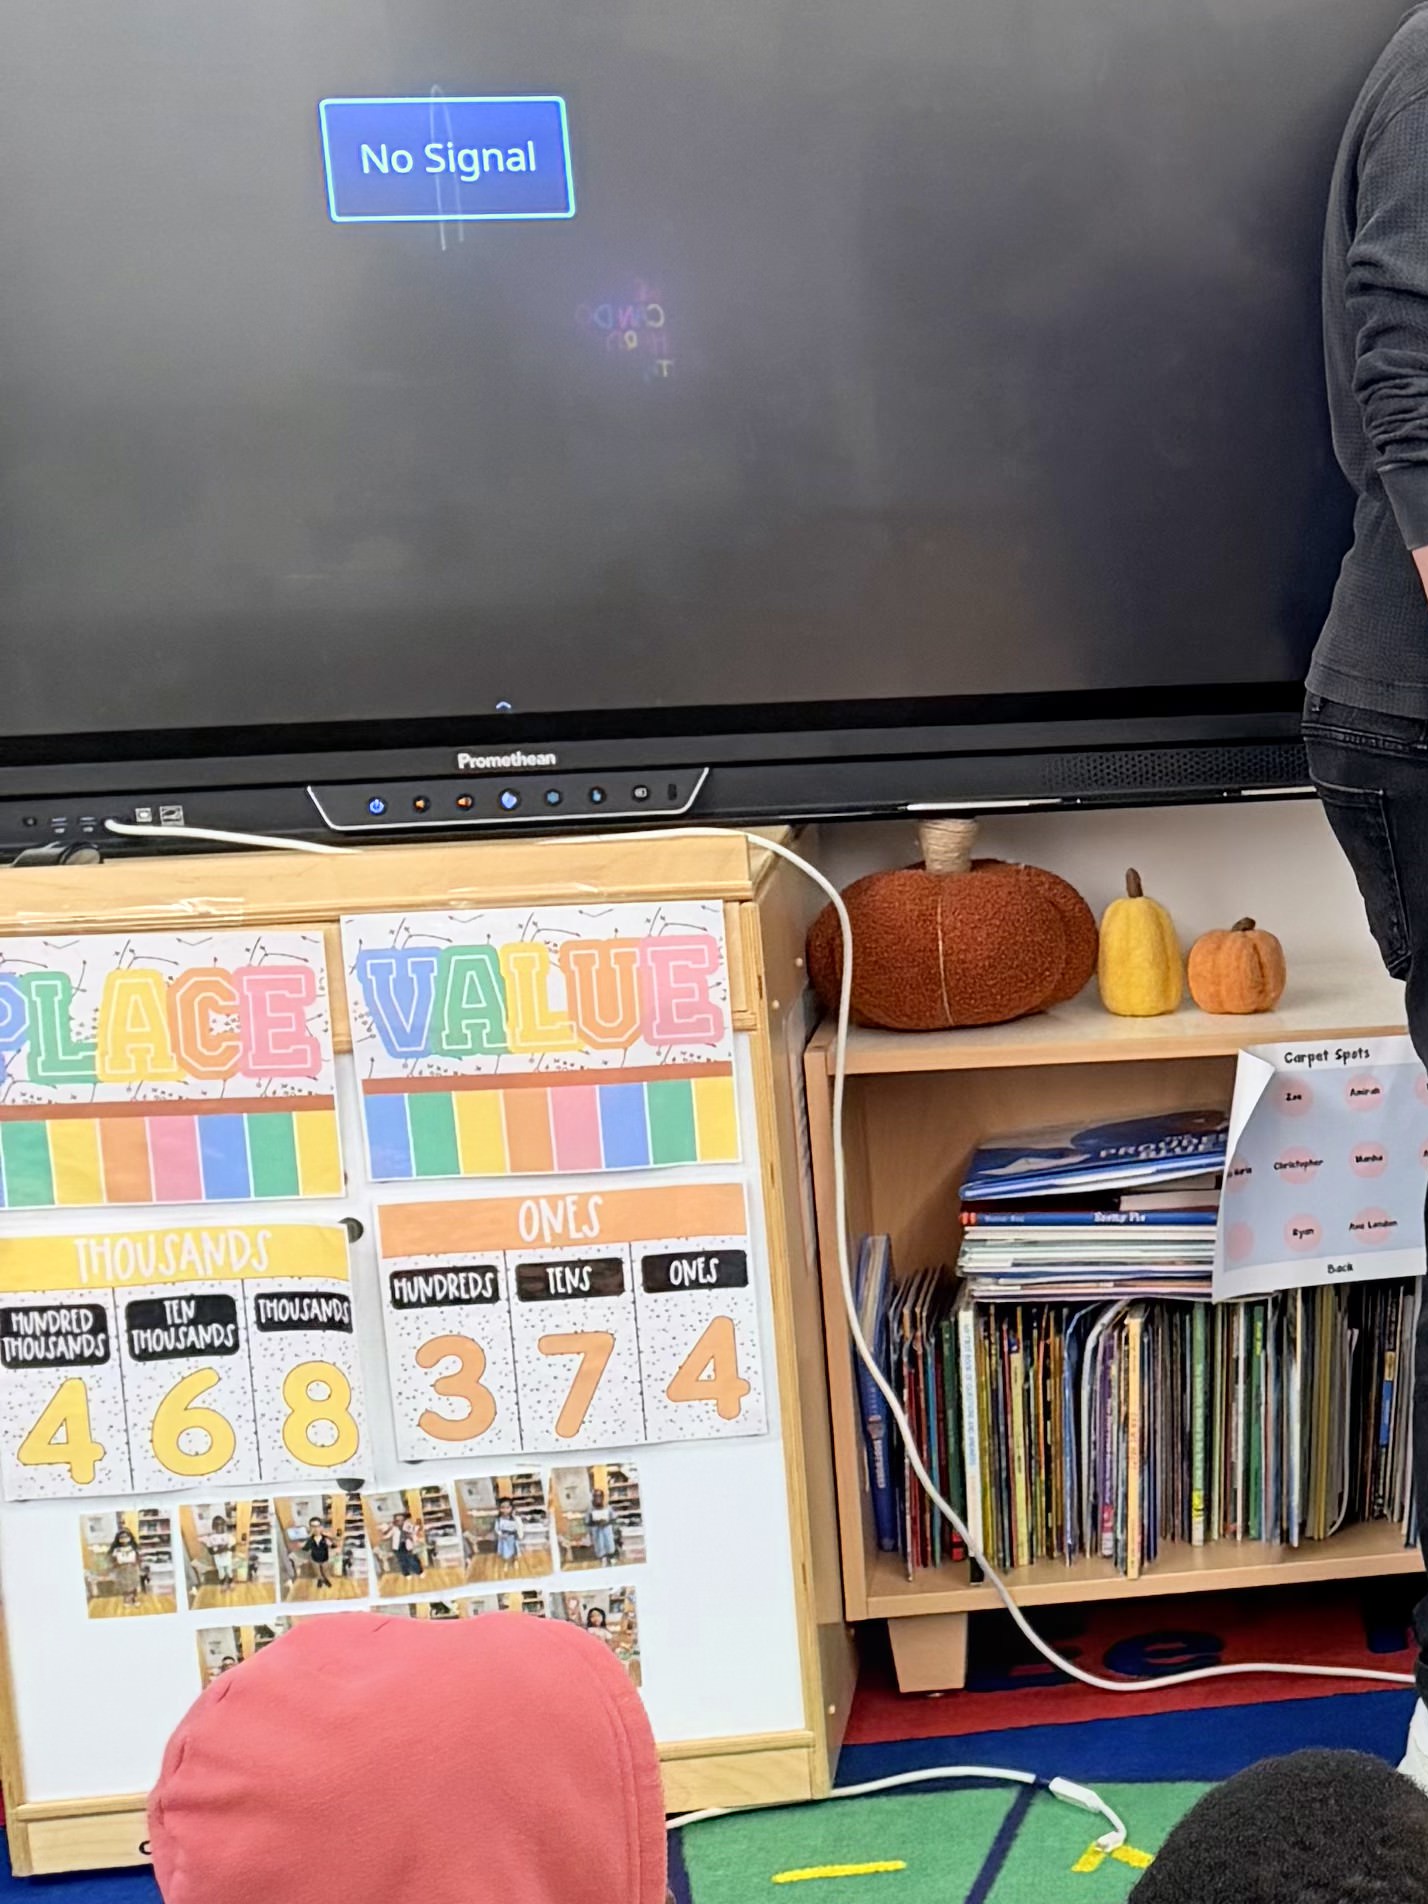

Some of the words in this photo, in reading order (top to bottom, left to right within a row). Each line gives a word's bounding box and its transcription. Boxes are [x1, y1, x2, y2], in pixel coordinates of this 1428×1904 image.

[359, 141, 414, 174] No
[423, 139, 537, 183] Signal
[456, 748, 557, 771] Promethean
[356, 934, 726, 1060] VALUE
[1284, 1047, 1329, 1069] Carpet
[1335, 1046, 1371, 1066] Spots
[518, 1196, 604, 1243] ONES
[74, 1228, 270, 1285] THOUSANDS
[668, 1256, 719, 1286] ONES
[391, 1269, 495, 1304] HUNDREDS
[546, 1263, 592, 1295] TENS
[10, 1306, 94, 1337] HUNDRED
[164, 1299, 198, 1326] TEN
[258, 1296, 350, 1326] THOUSANDS
[2, 1332, 105, 1363] THOUSANDS
[131, 1321, 236, 1352] THOUSANDS
[537, 1330, 616, 1439] 7
[665, 1315, 751, 1421] 4
[415, 1333, 498, 1443] 3
[17, 1377, 106, 1485] 4
[151, 1366, 237, 1477] 6
[281, 1360, 361, 1468] 8
